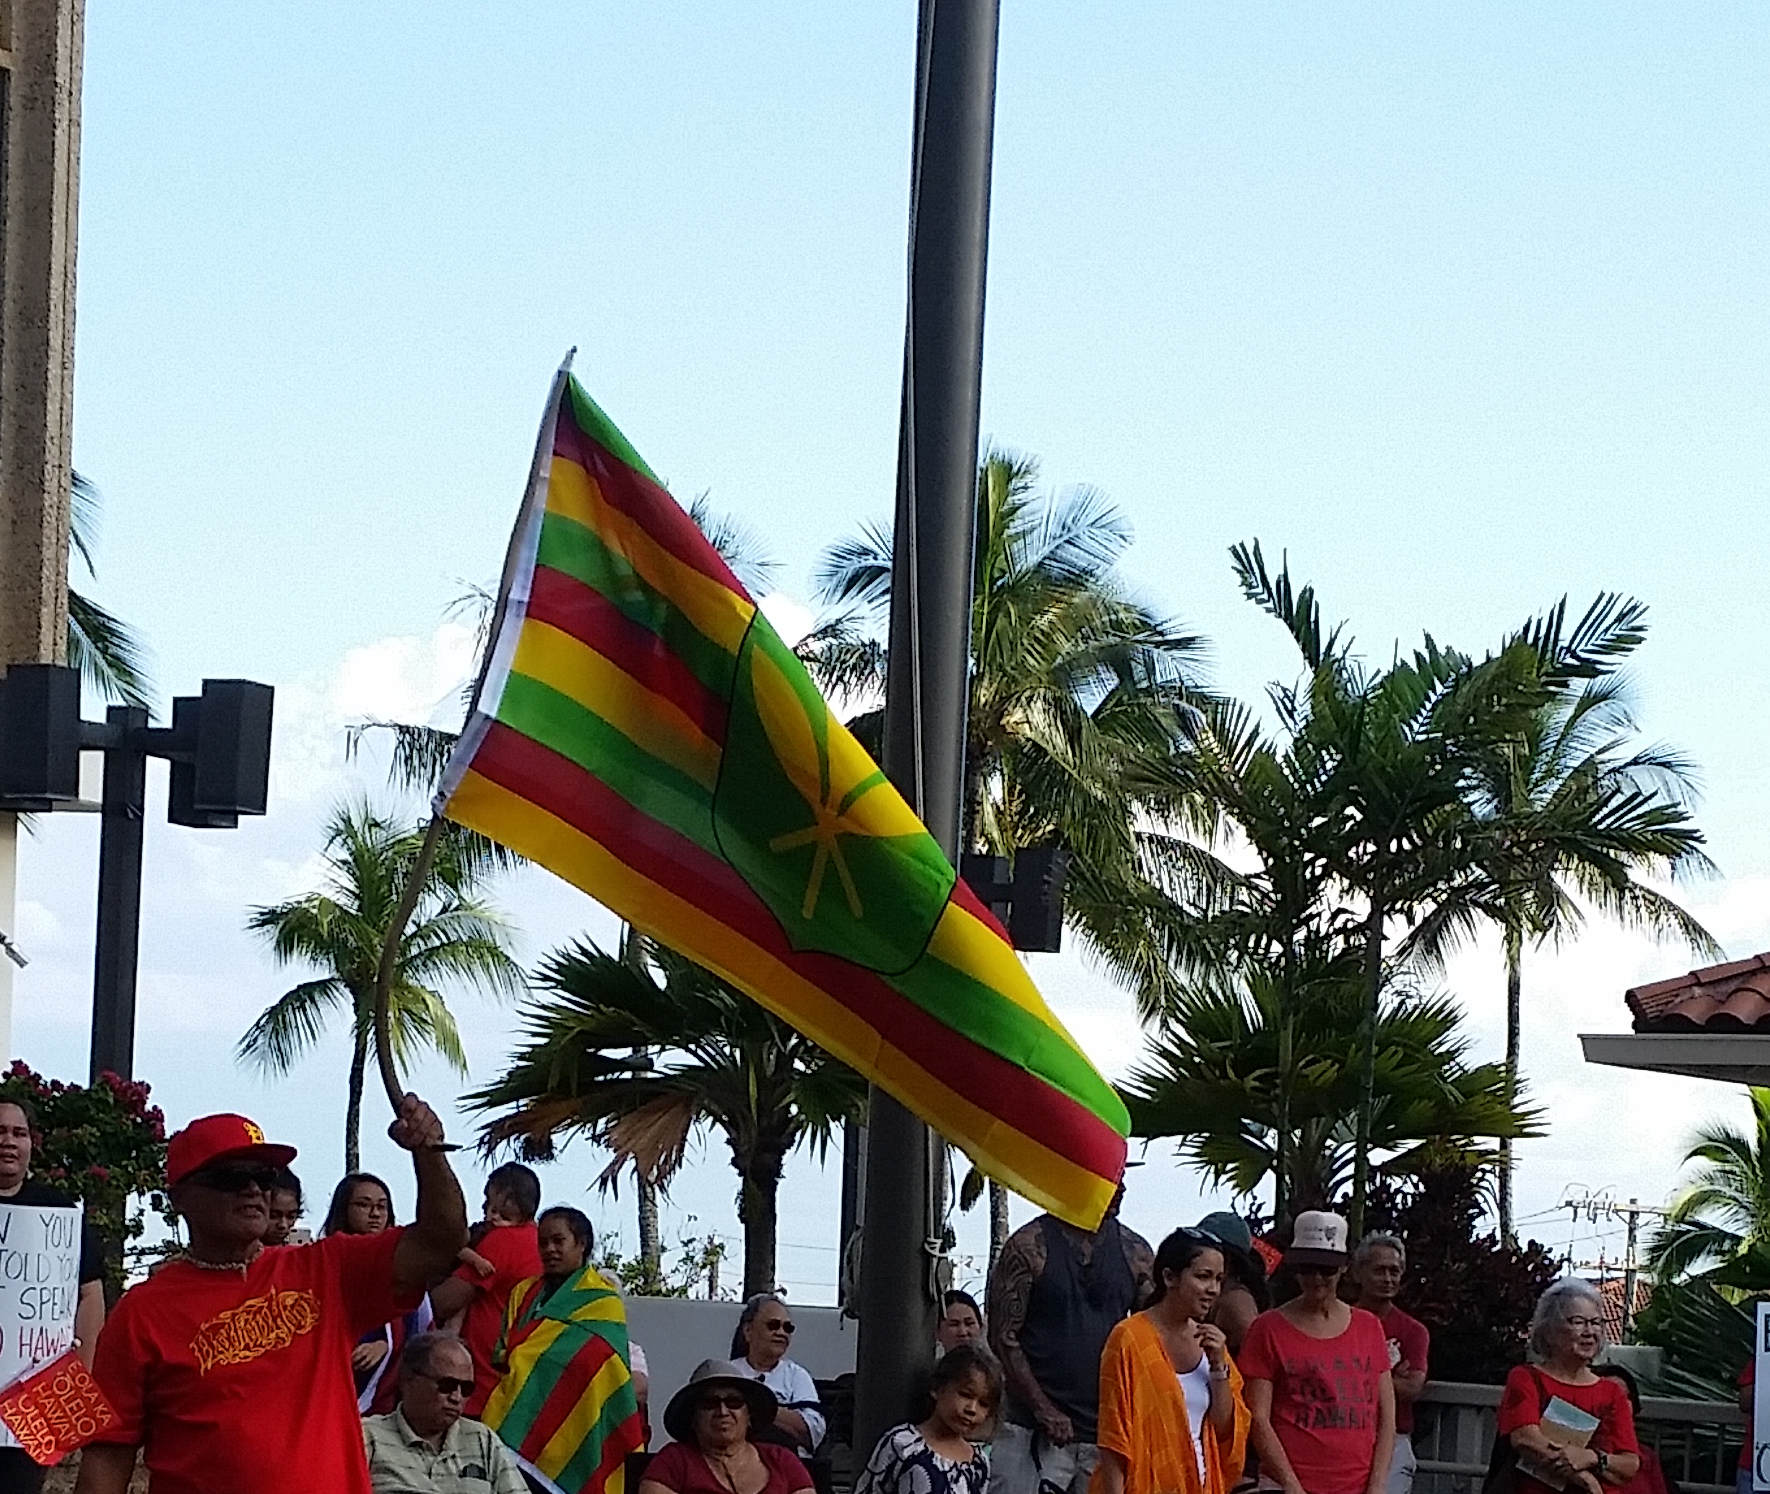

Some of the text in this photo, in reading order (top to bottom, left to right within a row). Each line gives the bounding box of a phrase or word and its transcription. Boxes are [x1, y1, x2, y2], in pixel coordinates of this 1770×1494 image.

[39, 1213, 75, 1251] YOU
[75, 1372, 99, 1404] OLA
[93, 1402, 112, 1428] KA
